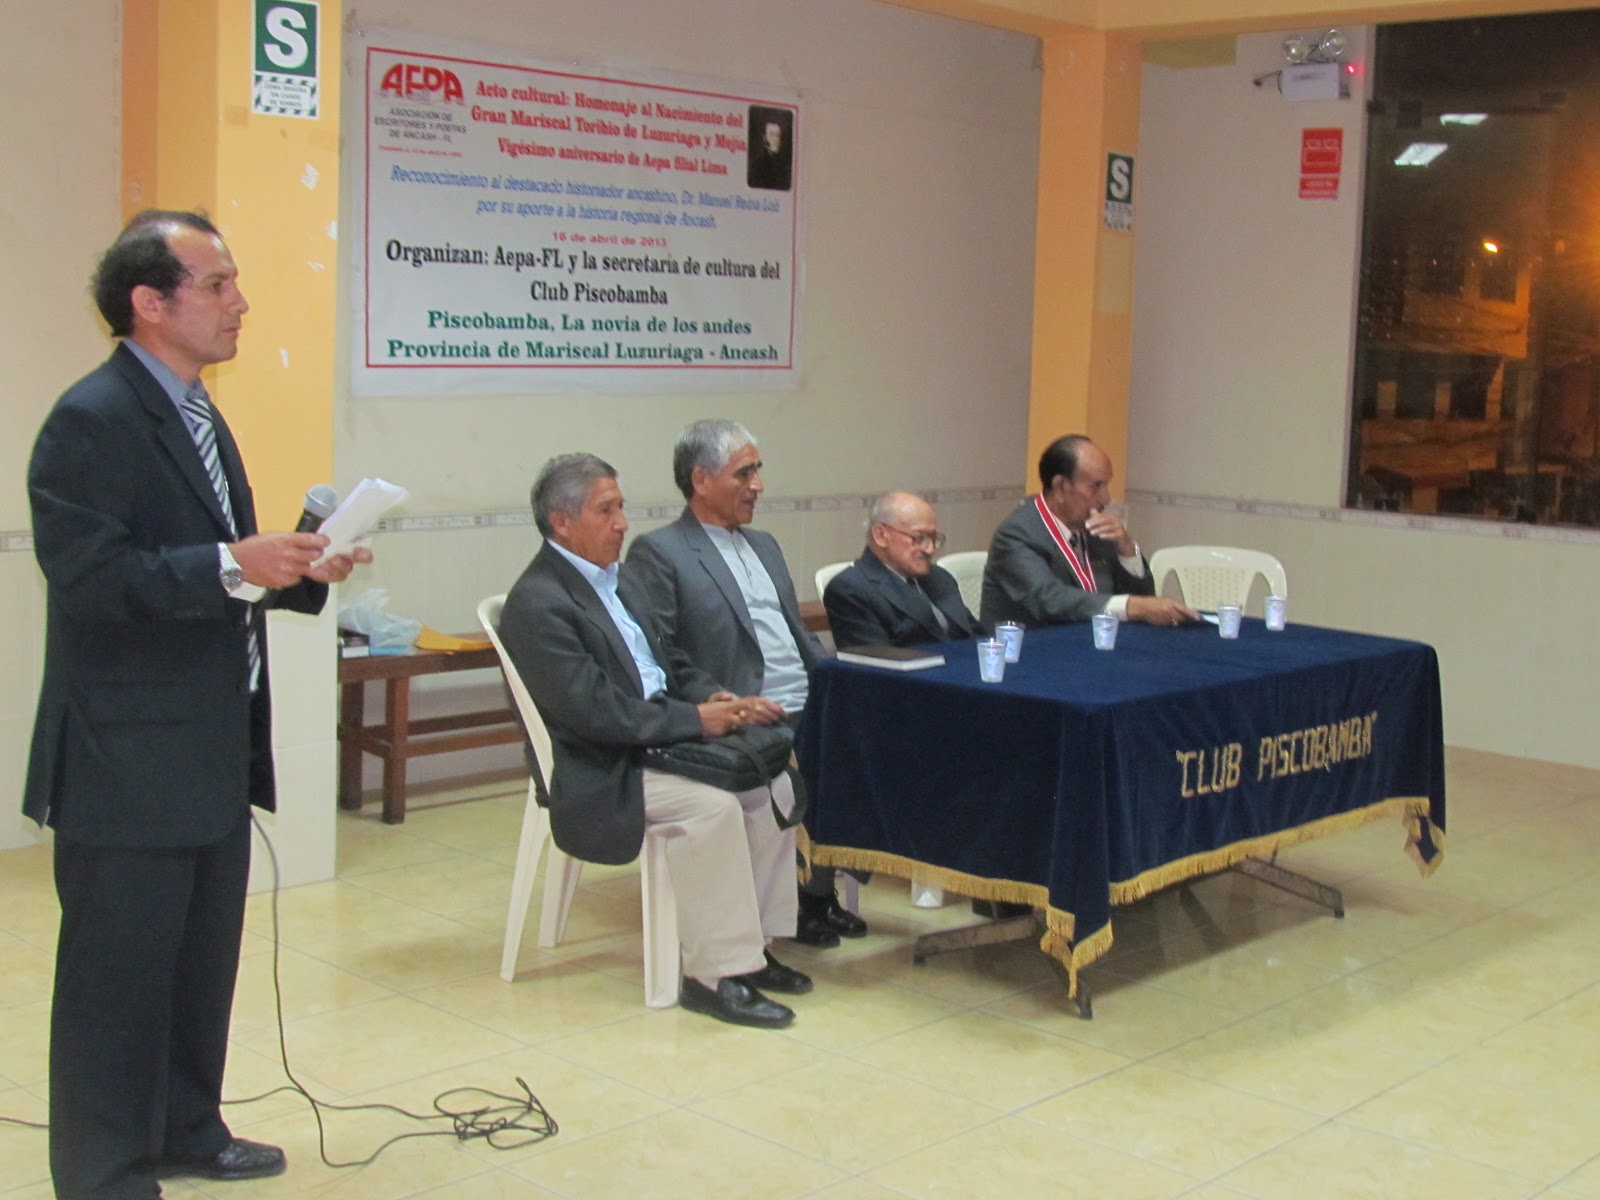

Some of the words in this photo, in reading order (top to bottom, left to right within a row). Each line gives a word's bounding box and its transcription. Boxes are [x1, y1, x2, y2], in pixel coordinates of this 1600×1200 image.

[264, 6, 309, 69] S
[381, 63, 464, 102] AEPA
[476, 80, 507, 99] Acto
[511, 86, 570, 107] cultural:
[574, 91, 638, 118] Homenaje
[641, 101, 652, 117] al
[655, 102, 724, 125] Nacimiento
[726, 112, 744, 129] del
[471, 105, 507, 124] Gran
[510, 109, 571, 131] Mariscal
[576, 116, 621, 137] Toribio
[623, 123, 638, 140] de
[641, 124, 702, 149] Luzuriaga
[704, 136, 711, 151] y
[558, 144, 625, 166] aniversario
[627, 150, 641, 166] de
[642, 152, 672, 172] Aepa
[700, 158, 728, 176] Lima
[391, 164, 489, 189] Reconocimiento
[490, 174, 502, 190] al
[503, 176, 564, 195] destacado
[1110, 158, 1130, 200] S
[475, 200, 497, 215] por
[500, 201, 514, 214] su
[516, 202, 555, 218] aporte
[556, 205, 564, 217] a
[566, 203, 577, 218] la
[578, 203, 619, 222] historia
[620, 209, 663, 226] regional
[663, 211, 678, 226] de
[570, 233, 586, 243] de
[590, 233, 618, 244] abril
[621, 235, 637, 246] de
[386, 239, 489, 268] Organizan:
[493, 246, 563, 272] Aepa-FL
[567, 254, 579, 274] y
[582, 250, 597, 271] la
[683, 256, 701, 277] de
[705, 258, 757, 279] cultura
[760, 261, 781, 281] del
[530, 280, 568, 302] Club
[574, 282, 668, 306] Piscobamba
[427, 310, 556, 333] Piscobamba,
[561, 313, 585, 331] La
[591, 315, 641, 333] novia
[646, 316, 667, 333] de
[672, 316, 698, 334] los
[702, 318, 752, 336] andes
[387, 339, 491, 359] Provincia
[497, 341, 520, 359] de
[525, 341, 609, 360] Mariscal
[614, 343, 704, 364] Luzuriaga
[719, 344, 779, 362] Ancash
